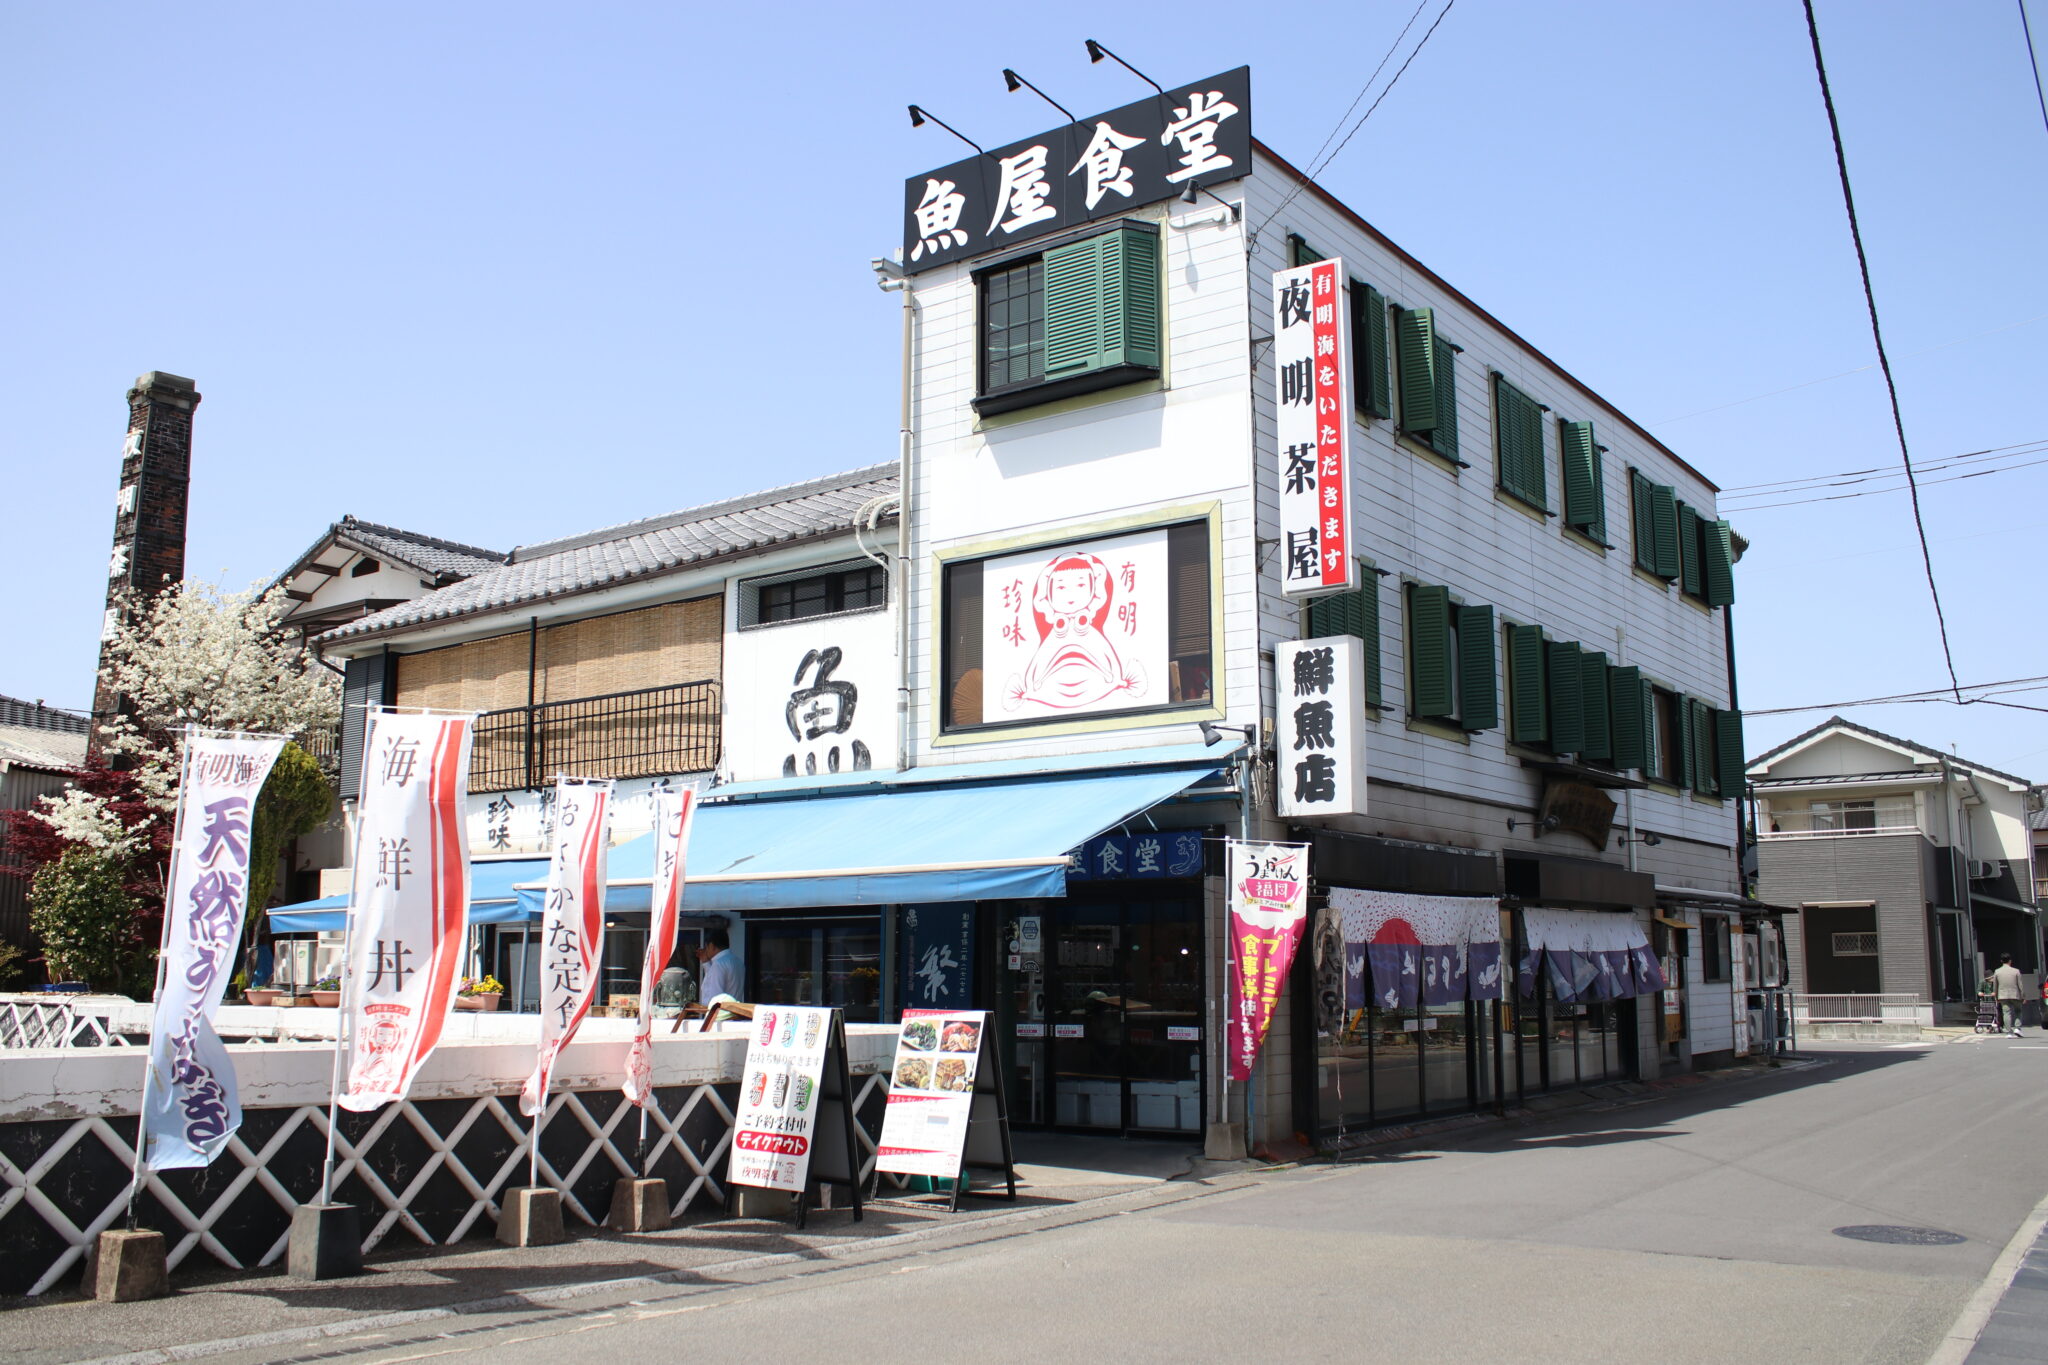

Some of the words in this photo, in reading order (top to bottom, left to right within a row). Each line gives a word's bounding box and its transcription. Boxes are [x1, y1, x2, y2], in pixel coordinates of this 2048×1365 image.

[910, 90, 1239, 261] 魚屋食堂
[1278, 277, 1321, 581] 夜明茶屋
[1315, 273, 1343, 571] 有明海をいただきます
[1001, 578, 1026, 648] 珍味
[1117, 561, 1137, 637] 有明
[1293, 646, 1337, 803] 鮮魚店
[487, 794, 515, 850] 珍味
[366, 735, 422, 993] 海鮮丼
[1255, 881, 1288, 898] 福岡
[781, 1011, 797, 1045] 刺身
[1239, 934, 1261, 1069] 食事券使えます
[804, 1012, 819, 1048] 揚物
[772, 1072, 787, 1107] 寿司
[794, 1073, 809, 1108] 惣菜
[740, 1132, 805, 1154] テイクアウト
[744, 1114, 807, 1132] ご予約受付中
[742, 1166, 780, 1182] 夜明茶屋
